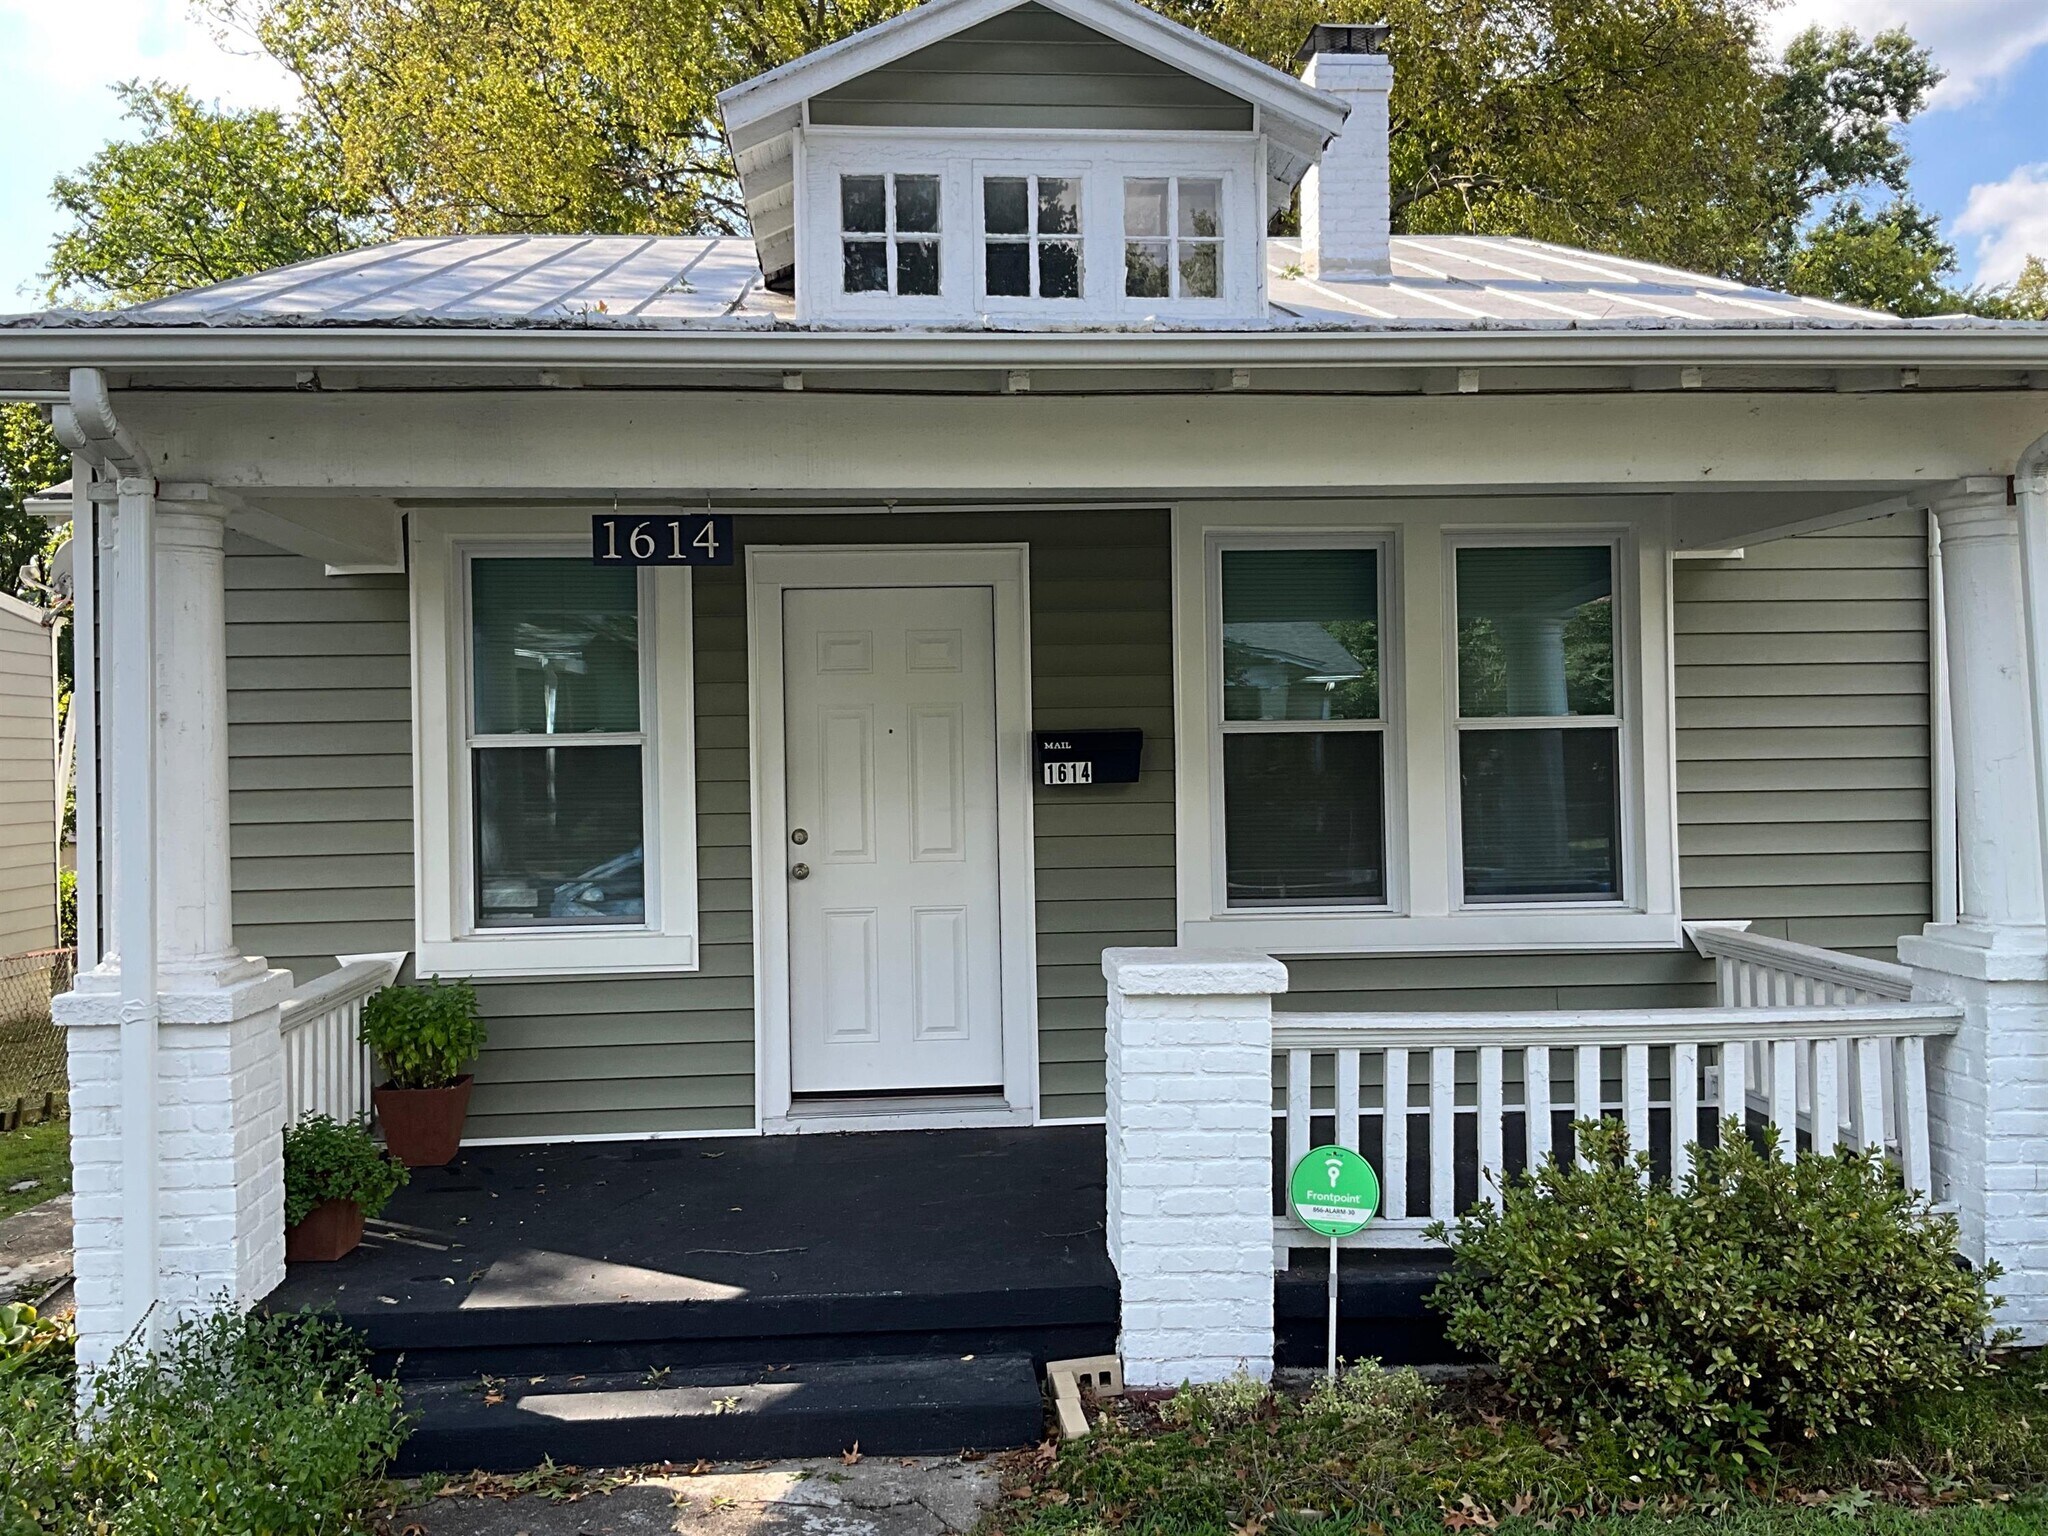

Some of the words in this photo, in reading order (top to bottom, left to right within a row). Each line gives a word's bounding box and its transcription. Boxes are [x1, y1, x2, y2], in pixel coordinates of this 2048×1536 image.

[602, 520, 720, 559] 1614
[1044, 741, 1072, 750] MAIL
[1047, 762, 1091, 784] 1614
[1306, 1190, 1361, 1204] Frontpoint
